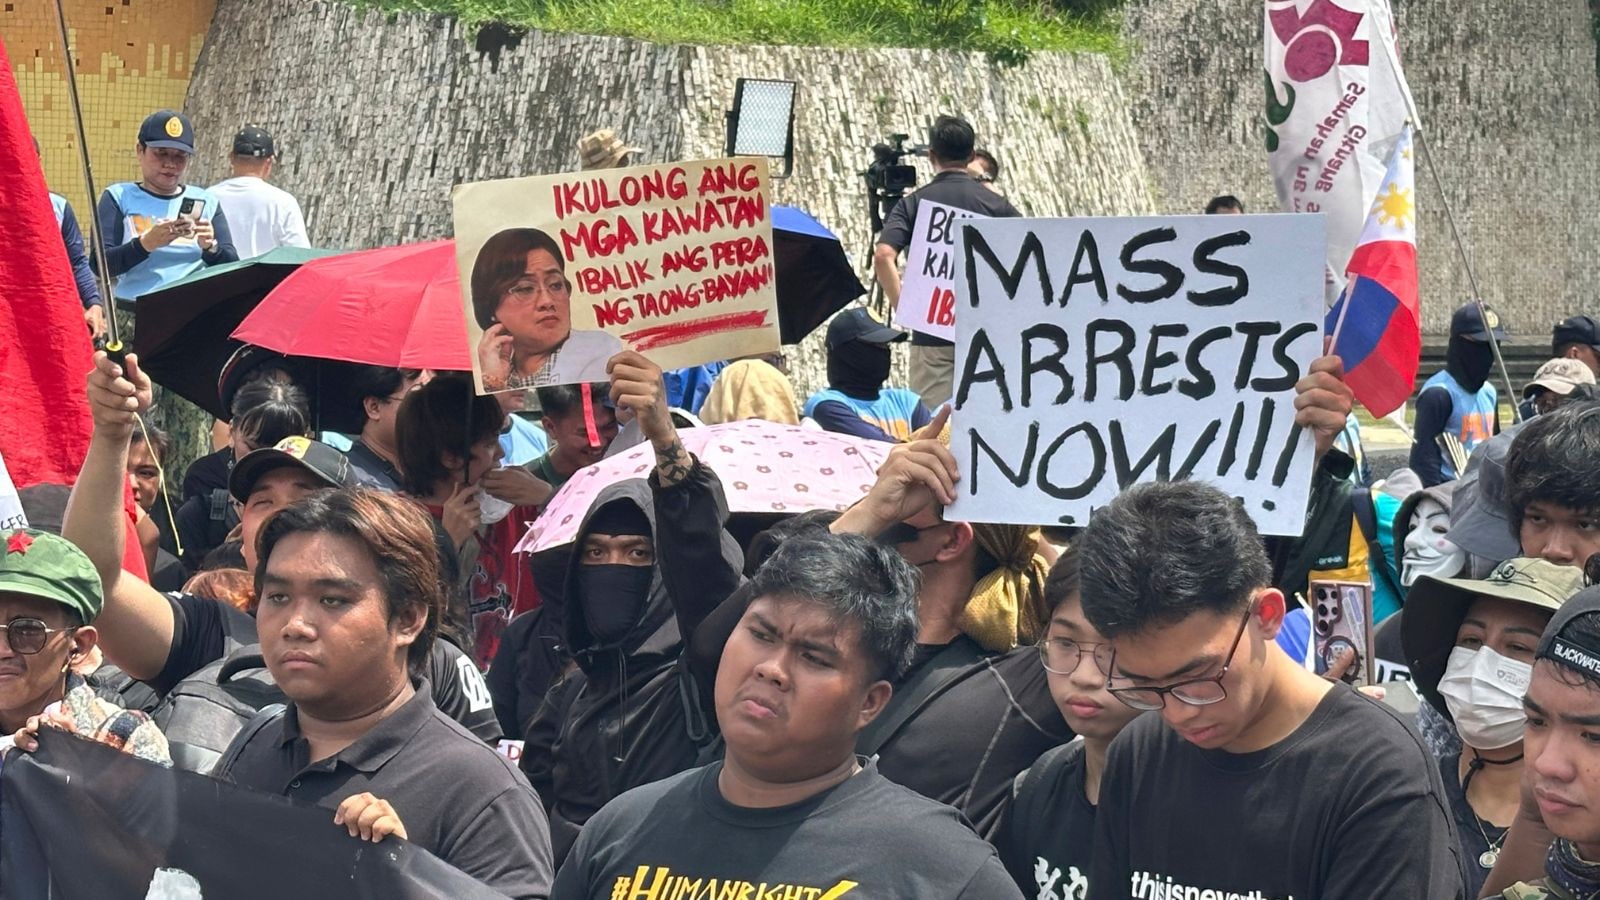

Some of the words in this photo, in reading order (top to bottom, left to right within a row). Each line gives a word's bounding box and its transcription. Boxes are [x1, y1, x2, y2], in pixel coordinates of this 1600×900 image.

[553, 168, 688, 220] IKULONG
[697, 162, 760, 197] ANG
[560, 215, 638, 262] MGA
[642, 192, 765, 245] KAWATAN
[576, 258, 655, 295] IBALIK
[661, 244, 708, 279] ANG
[710, 235, 769, 269] PERA
[922, 247, 955, 280] KA
[962, 224, 1251, 308] MASS
[592, 298, 634, 328] NG
[927, 286, 956, 326] IB
[954, 318, 1318, 412] ARRESTS
[968, 397, 1303, 511] NOW!!!
